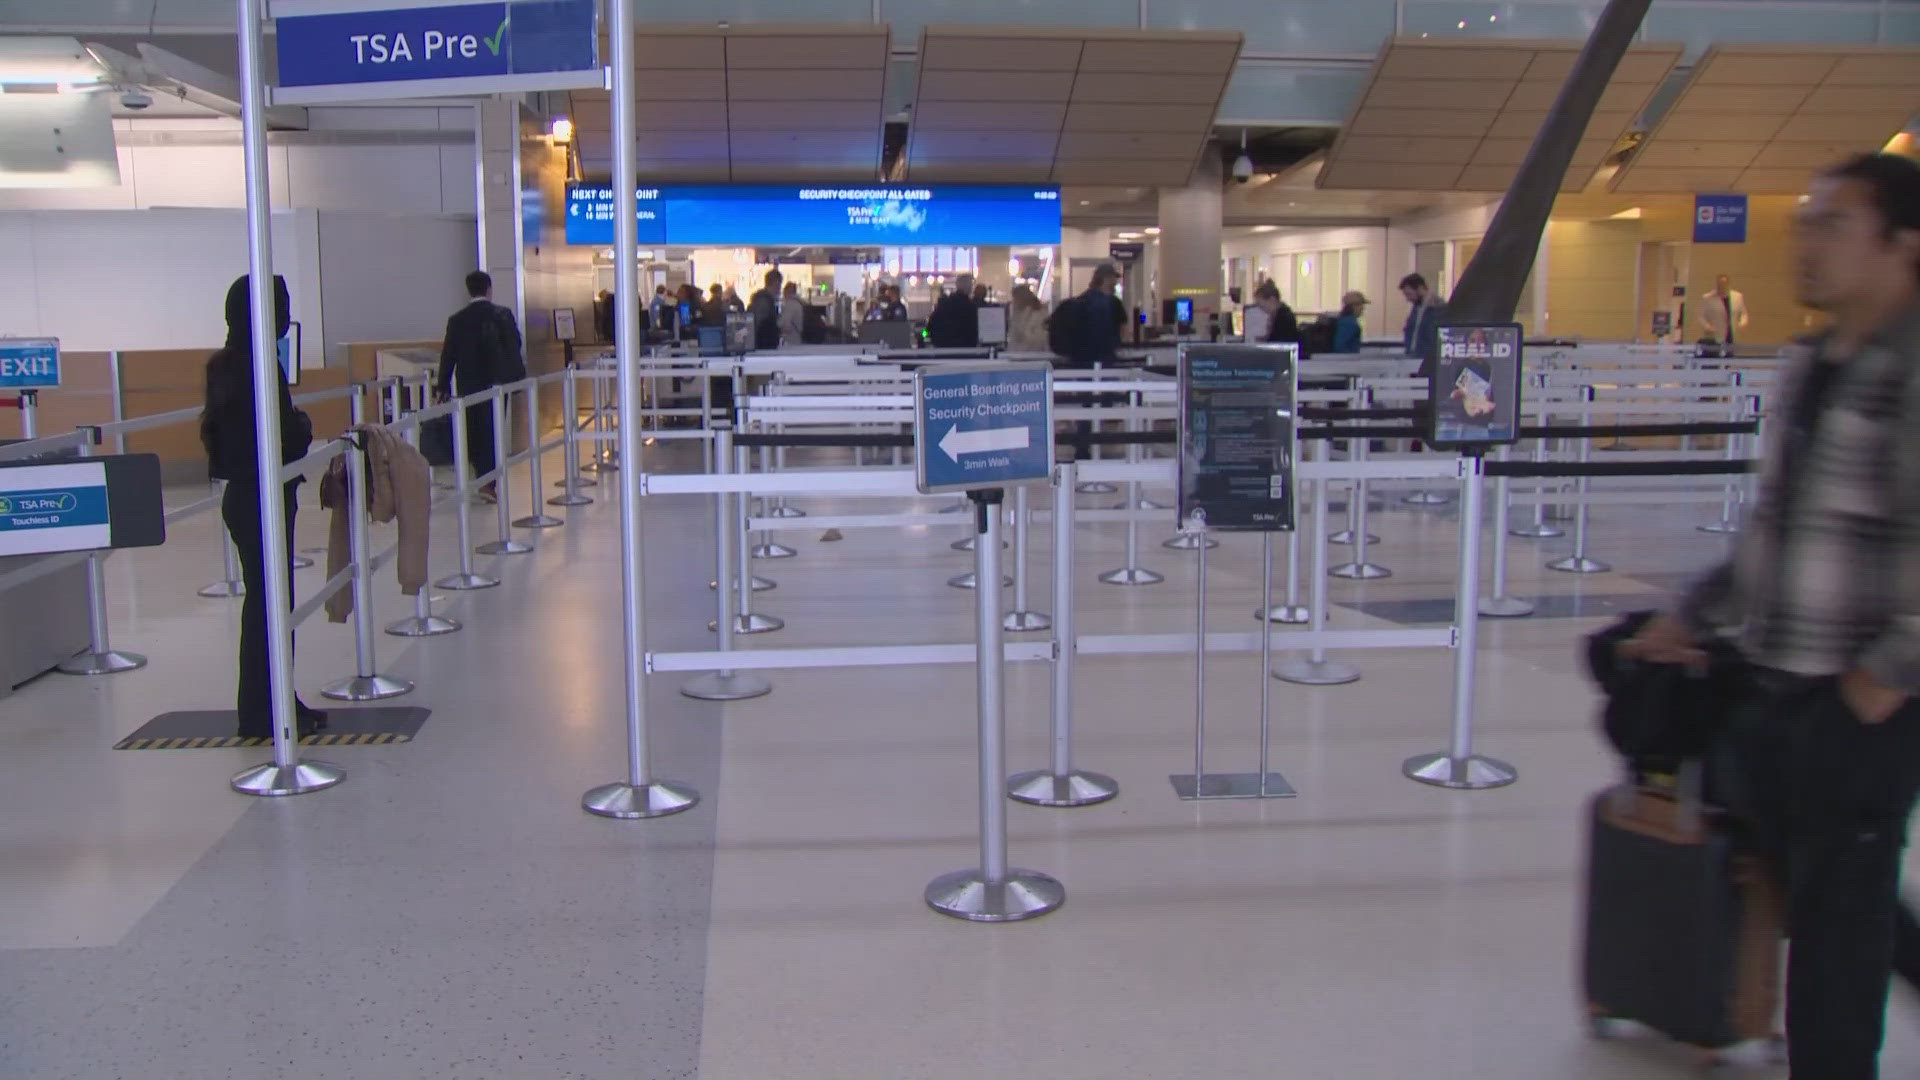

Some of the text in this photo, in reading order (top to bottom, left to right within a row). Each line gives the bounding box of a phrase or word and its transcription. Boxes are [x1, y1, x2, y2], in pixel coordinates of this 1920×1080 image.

[350, 30, 478, 64] TSA Pre
[571, 189, 597, 200] NEXT
[799, 189, 931, 200] SECURITY CHECKPOINT ALL GATES
[1440, 343, 1511, 358] REAL ID
[0, 357, 52, 376] EXIT
[923, 380, 1045, 399] General Boarding next
[928, 400, 1041, 420] Security Checkpoint
[963, 456, 1010, 470] 3min Walk
[19, 500, 38, 510] TSA
[39, 499, 55, 509] Pre
[12, 515, 60, 526] Touchless ID
